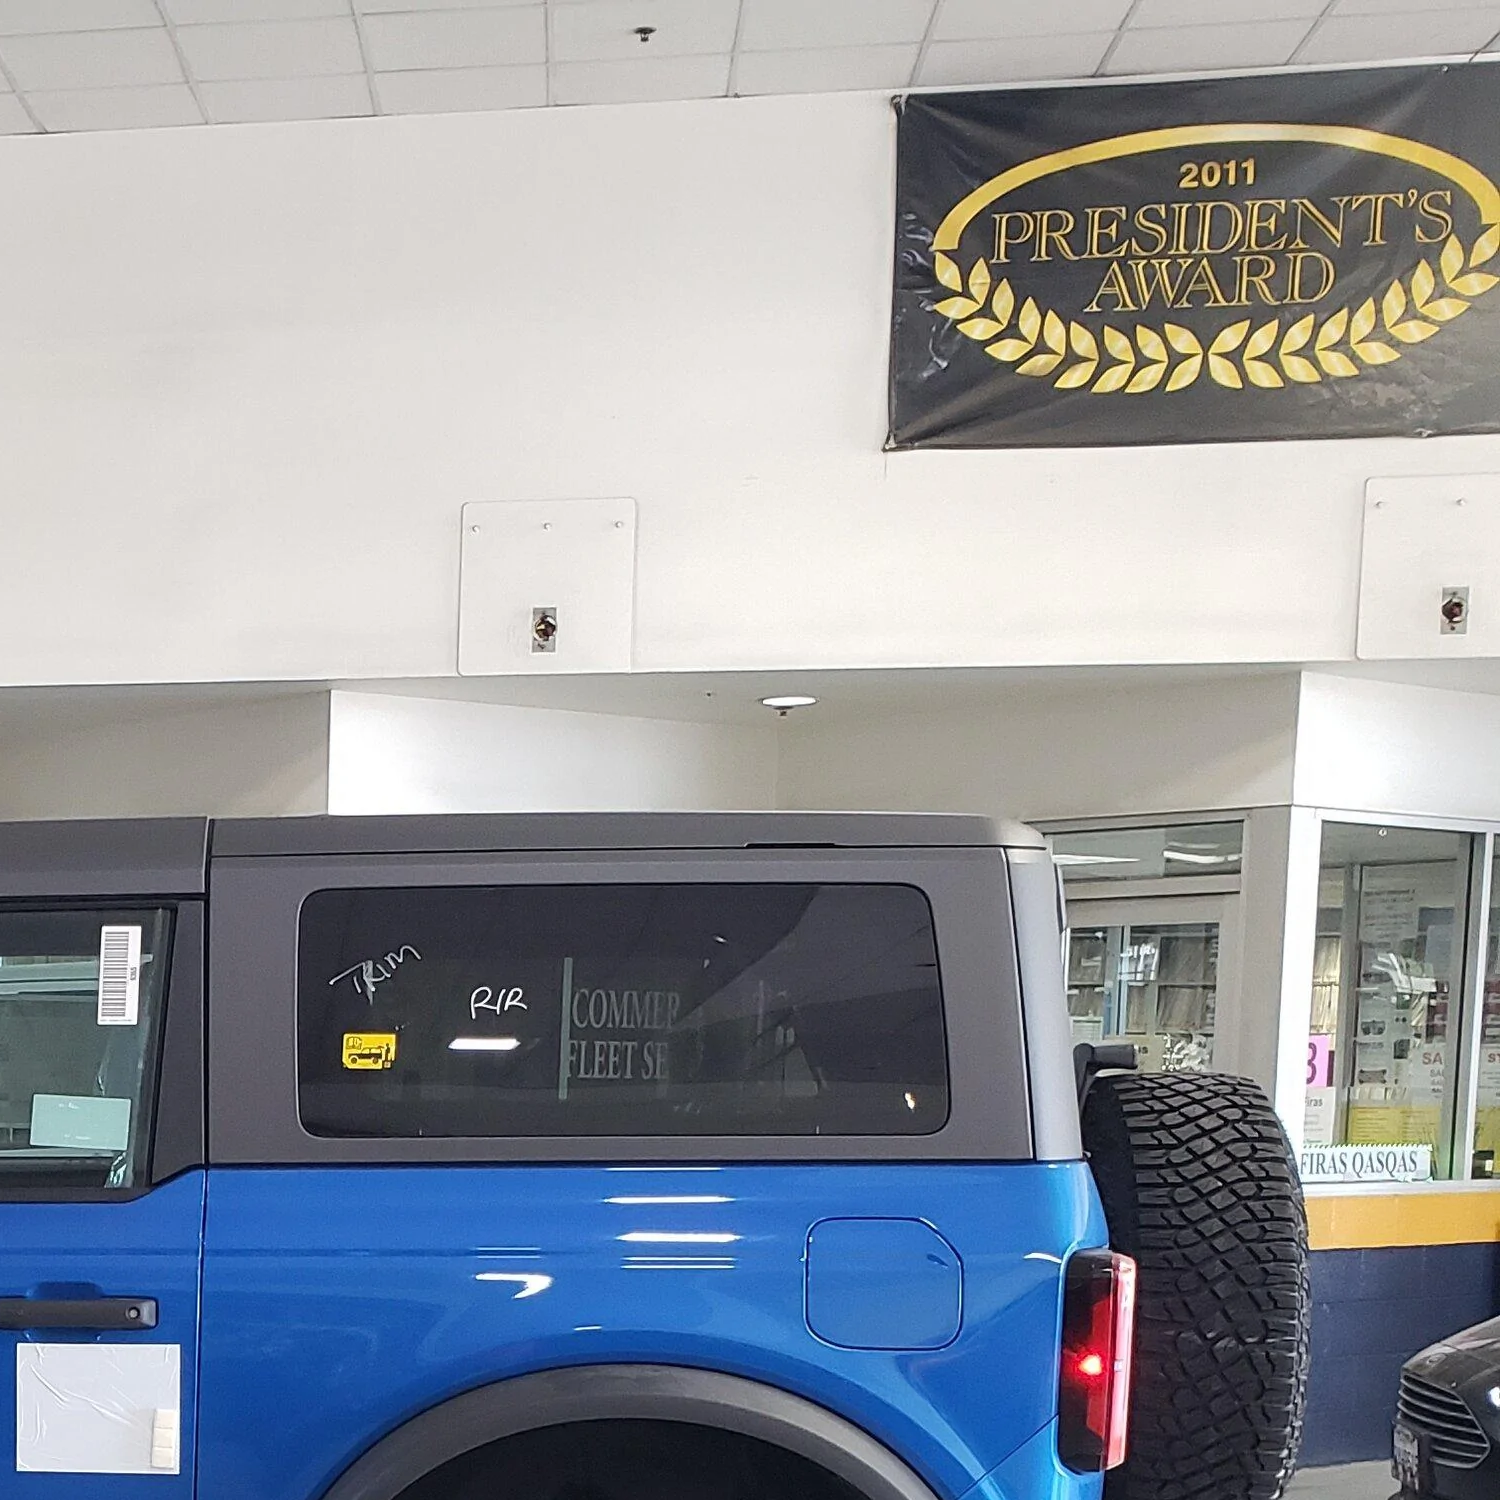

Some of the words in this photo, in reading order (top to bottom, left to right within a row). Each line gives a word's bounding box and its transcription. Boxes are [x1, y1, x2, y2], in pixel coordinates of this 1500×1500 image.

[1178, 158, 1256, 188] 2011
[989, 188, 1453, 264] PRESIDENT'S
[1083, 250, 1336, 313] AWARD
[567, 1040, 638, 1079] FLEET
[1300, 1152, 1347, 1175] FIRAS
[1352, 1150, 1417, 1178] QASQAS
